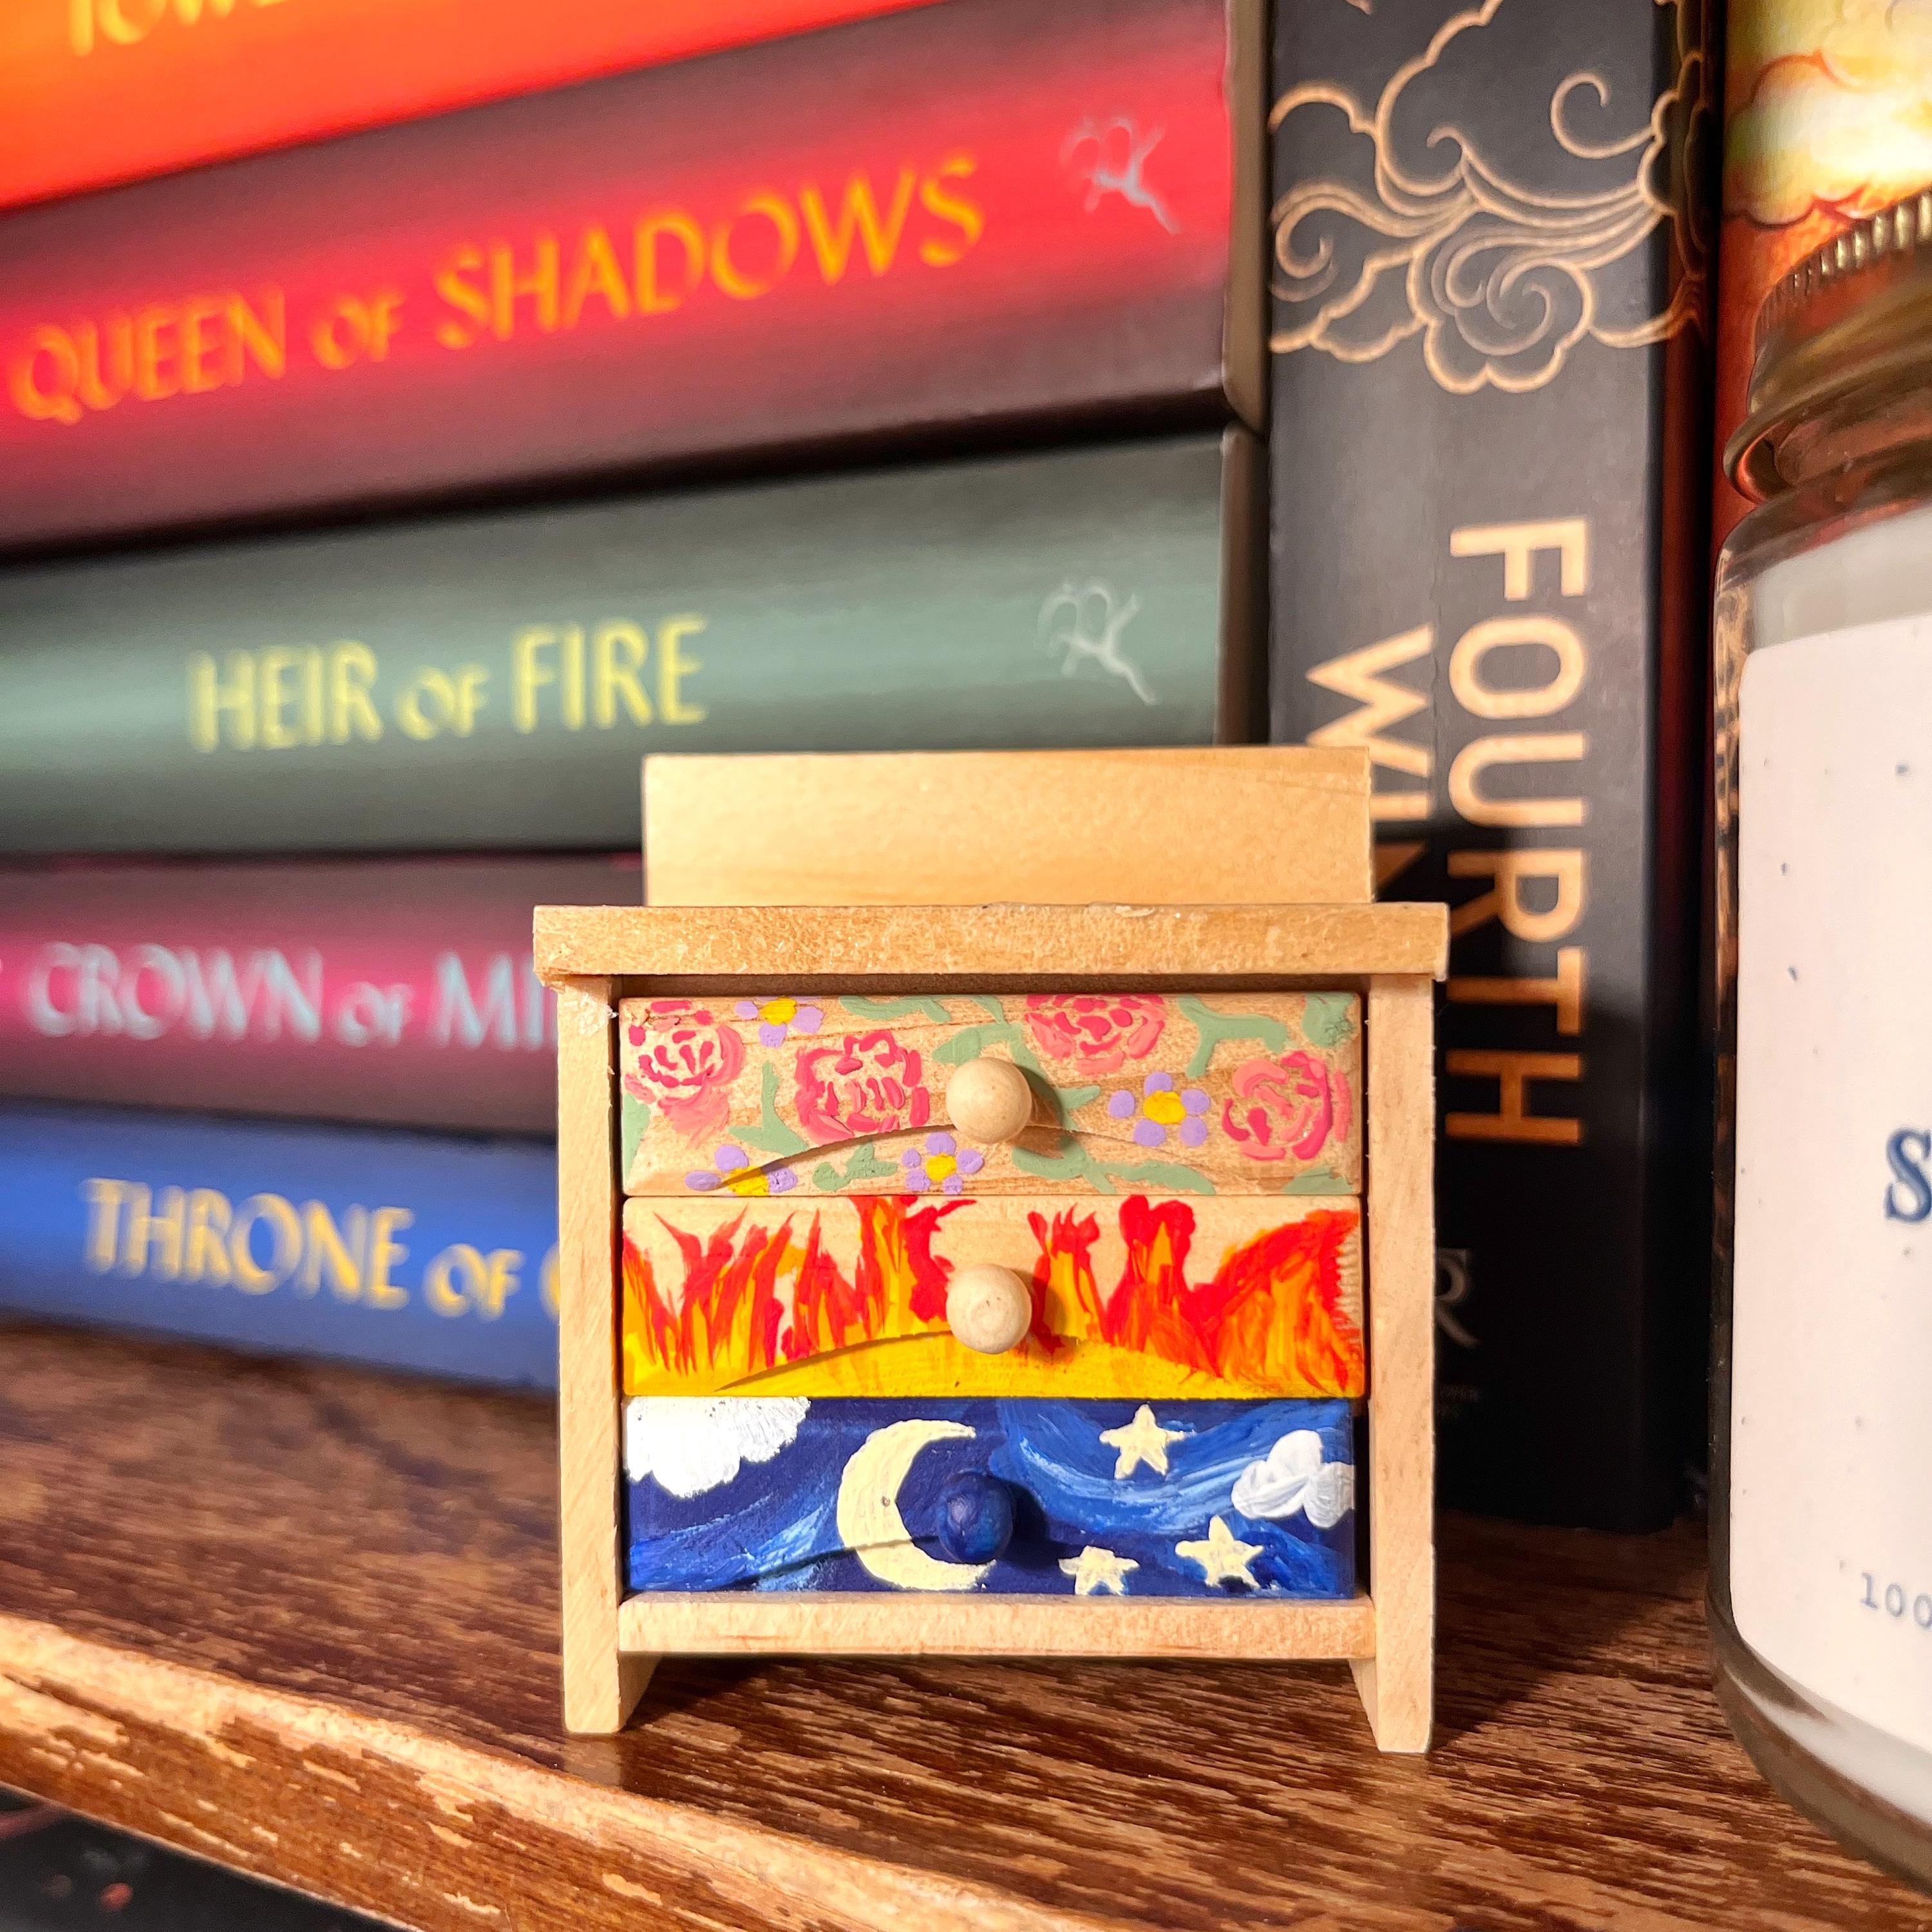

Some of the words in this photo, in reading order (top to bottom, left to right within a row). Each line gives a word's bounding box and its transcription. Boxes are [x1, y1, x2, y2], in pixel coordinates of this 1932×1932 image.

[9, 284, 287, 425] QUEEN
[434, 155, 985, 351] SHADOWS
[187, 639, 384, 753] HEIR
[514, 612, 707, 734] FIRE
[1306, 624, 1432, 899] WI
[1446, 519, 1587, 1146] FOURTH
[24, 942, 324, 1042] CROWN
[433, 952, 559, 1051] MI
[80, 1177, 415, 1311] THRONE
